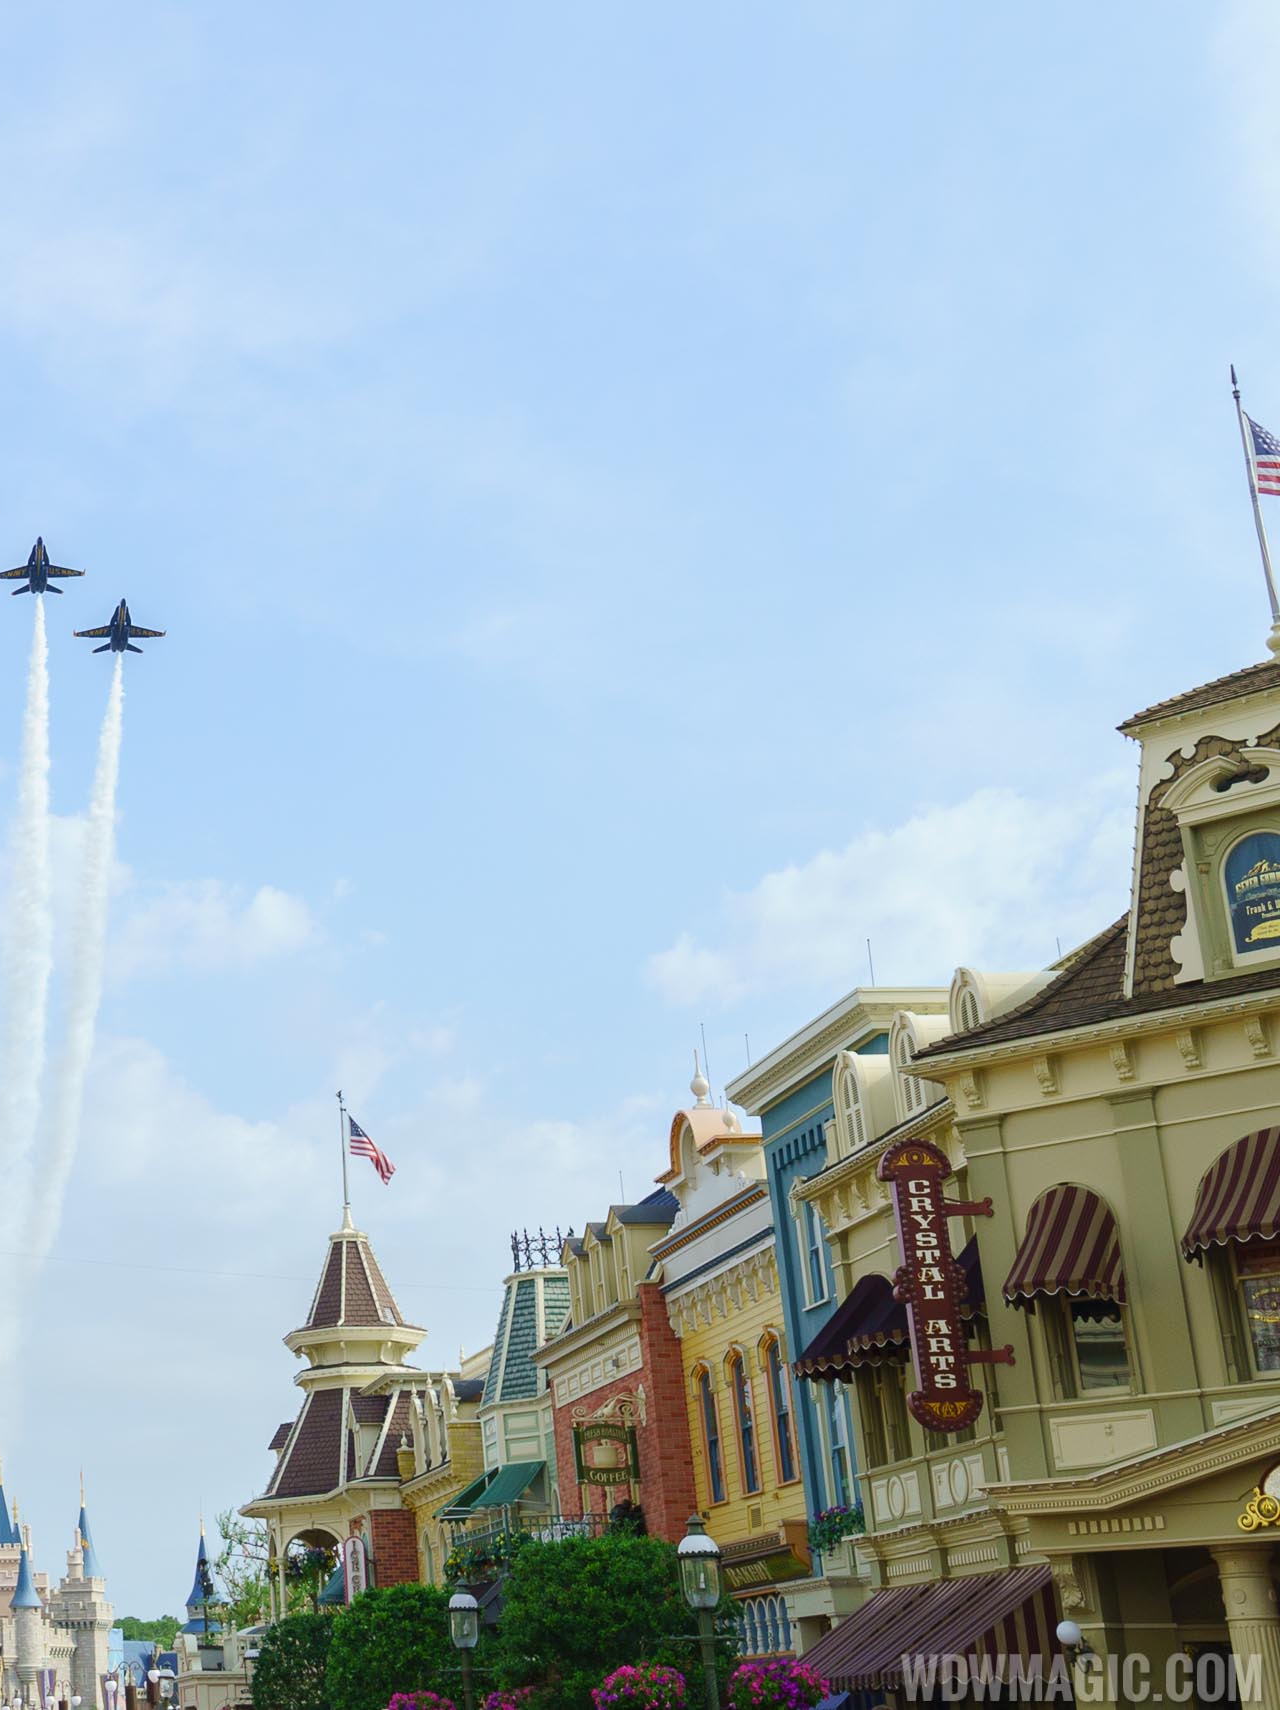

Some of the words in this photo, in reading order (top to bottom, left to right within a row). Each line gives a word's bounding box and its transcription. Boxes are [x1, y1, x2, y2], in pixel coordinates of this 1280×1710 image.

[907, 1180, 945, 1300] CRYSTAL
[925, 1320, 957, 1389] ARTS
[589, 1470, 628, 1483] COFFEE
